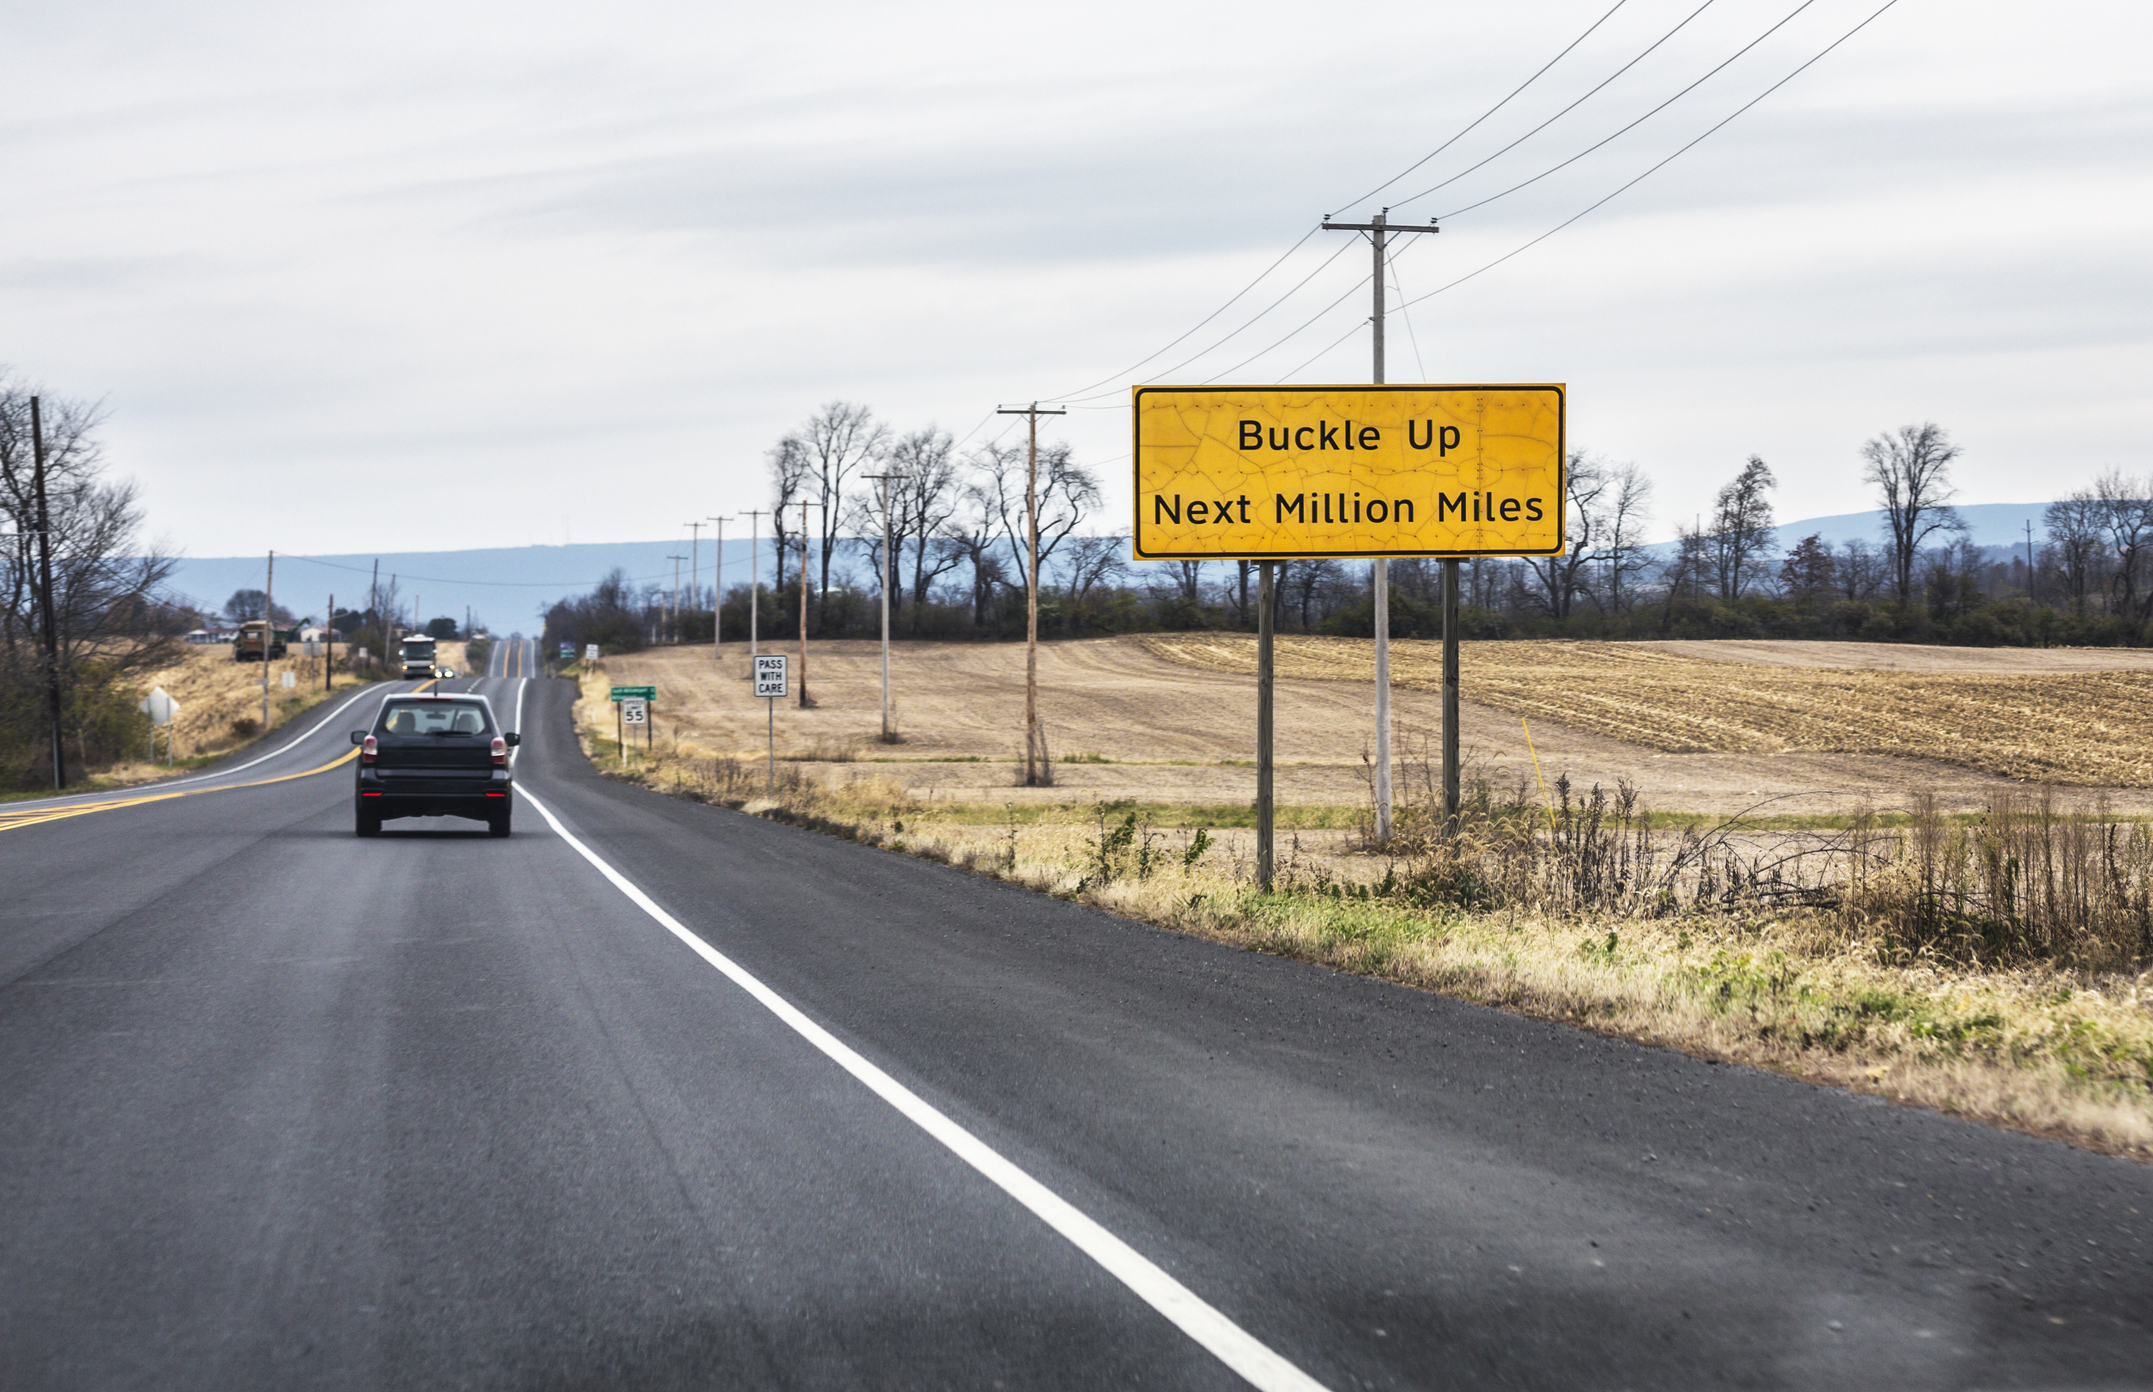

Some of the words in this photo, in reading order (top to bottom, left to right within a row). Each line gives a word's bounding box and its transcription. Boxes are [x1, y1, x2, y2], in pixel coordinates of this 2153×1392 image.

[1239, 419, 1381, 451] Buckle
[1408, 419, 1461, 458] Up
[1154, 494, 1251, 525] Next
[1276, 493, 1414, 524] Million
[1438, 491, 1543, 522] Miles
[758, 659, 783, 669] PASS
[760, 671, 782, 681] WITH
[758, 683, 783, 693] CARE
[626, 710, 644, 722] 55
